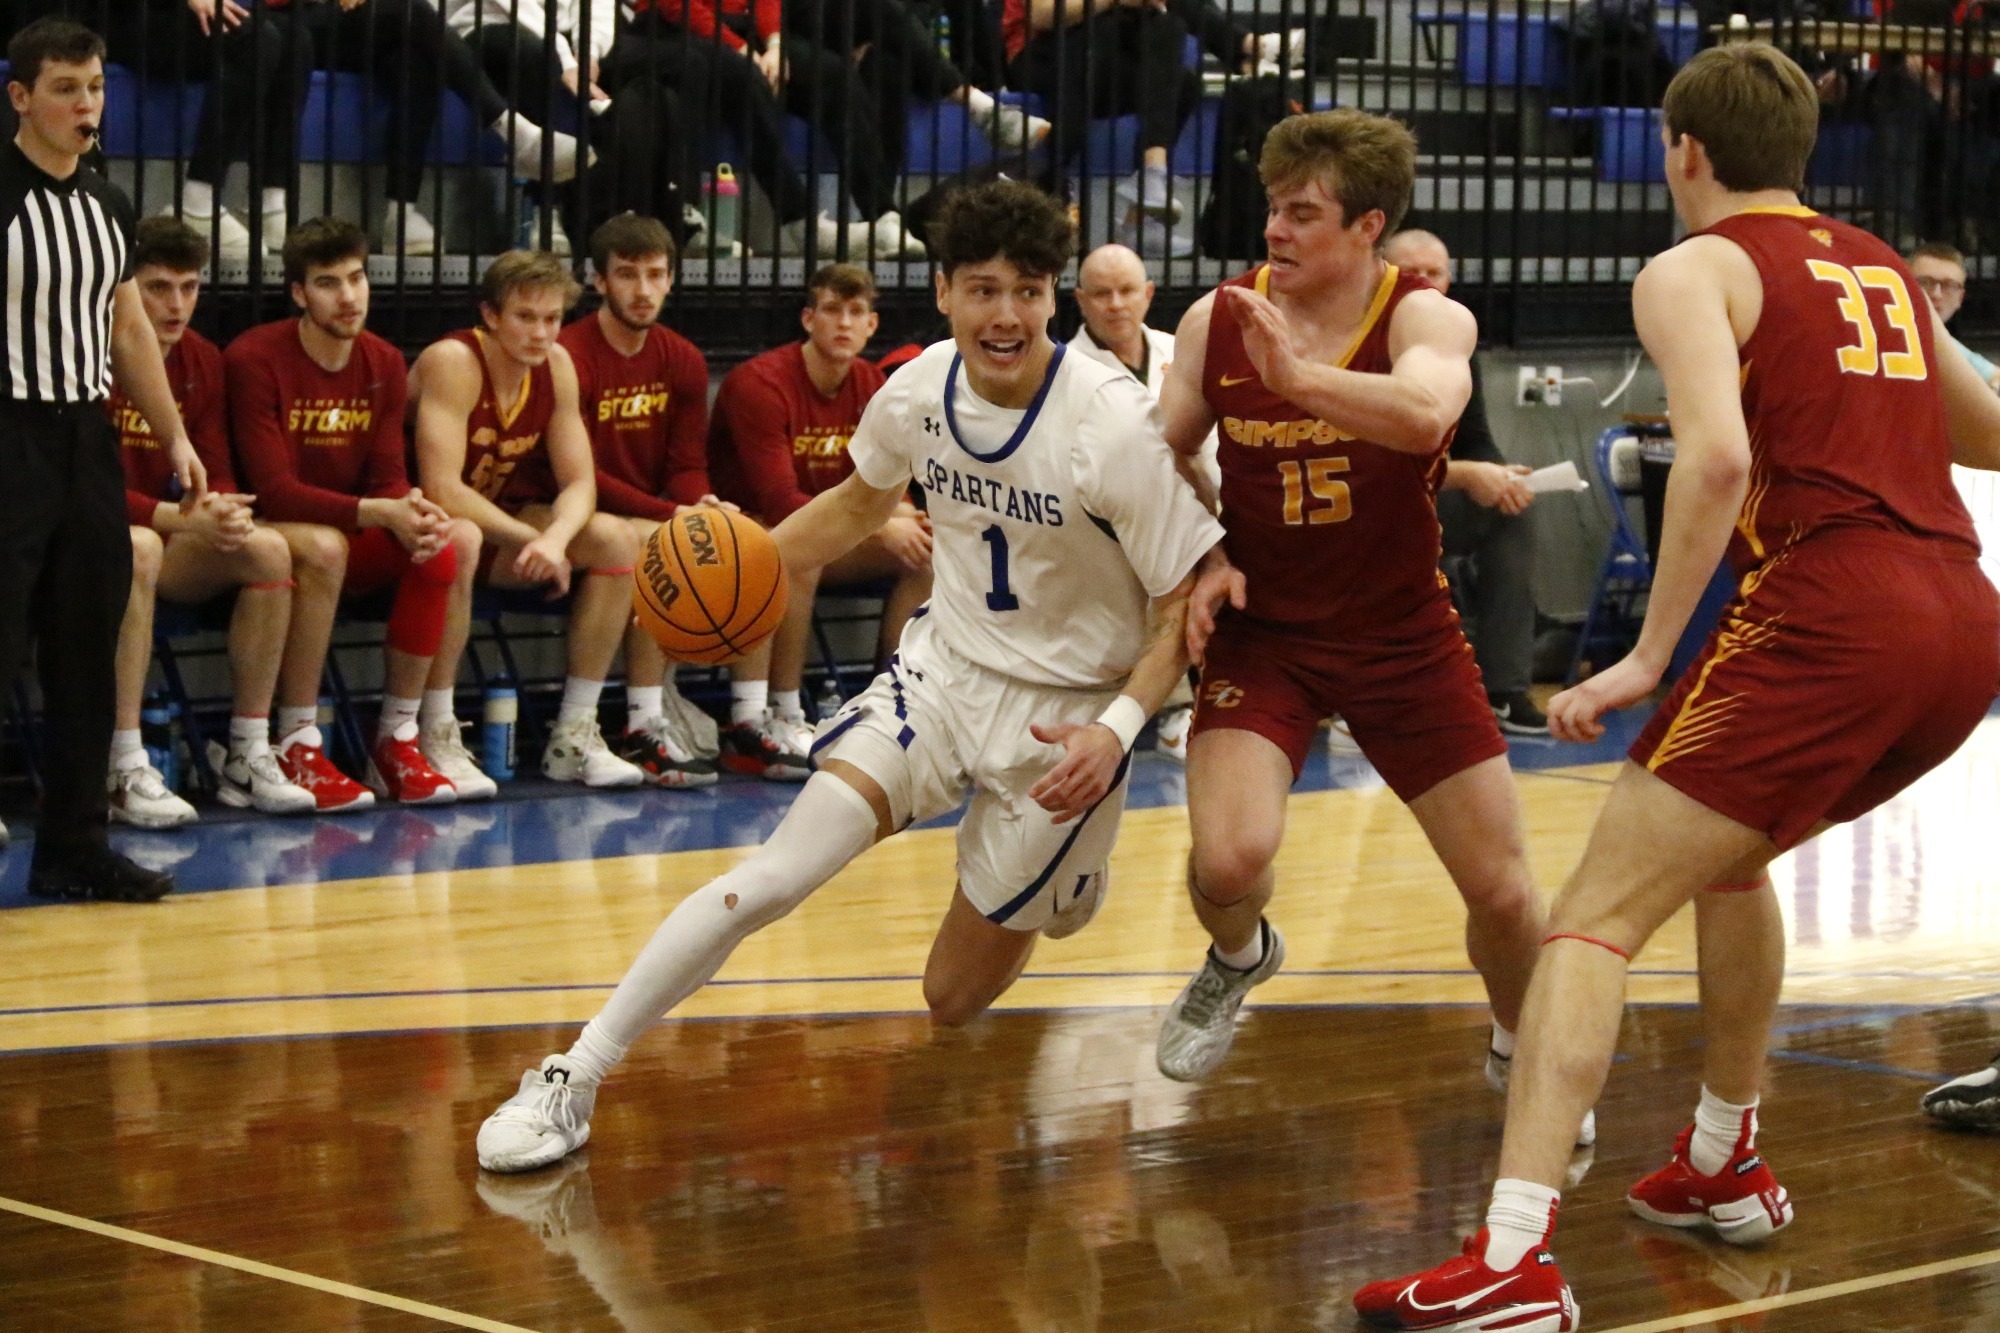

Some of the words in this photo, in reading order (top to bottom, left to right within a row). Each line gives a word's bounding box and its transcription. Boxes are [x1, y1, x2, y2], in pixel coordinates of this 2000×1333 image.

[1805, 259, 1928, 381] 33
[288, 408, 372, 433] STORM
[598, 392, 669, 422] STORM
[1223, 416, 1356, 448] SIMPS
[922, 457, 1064, 527] SPARTANS
[1277, 456, 1353, 525] 15
[981, 523, 1020, 612] 1
